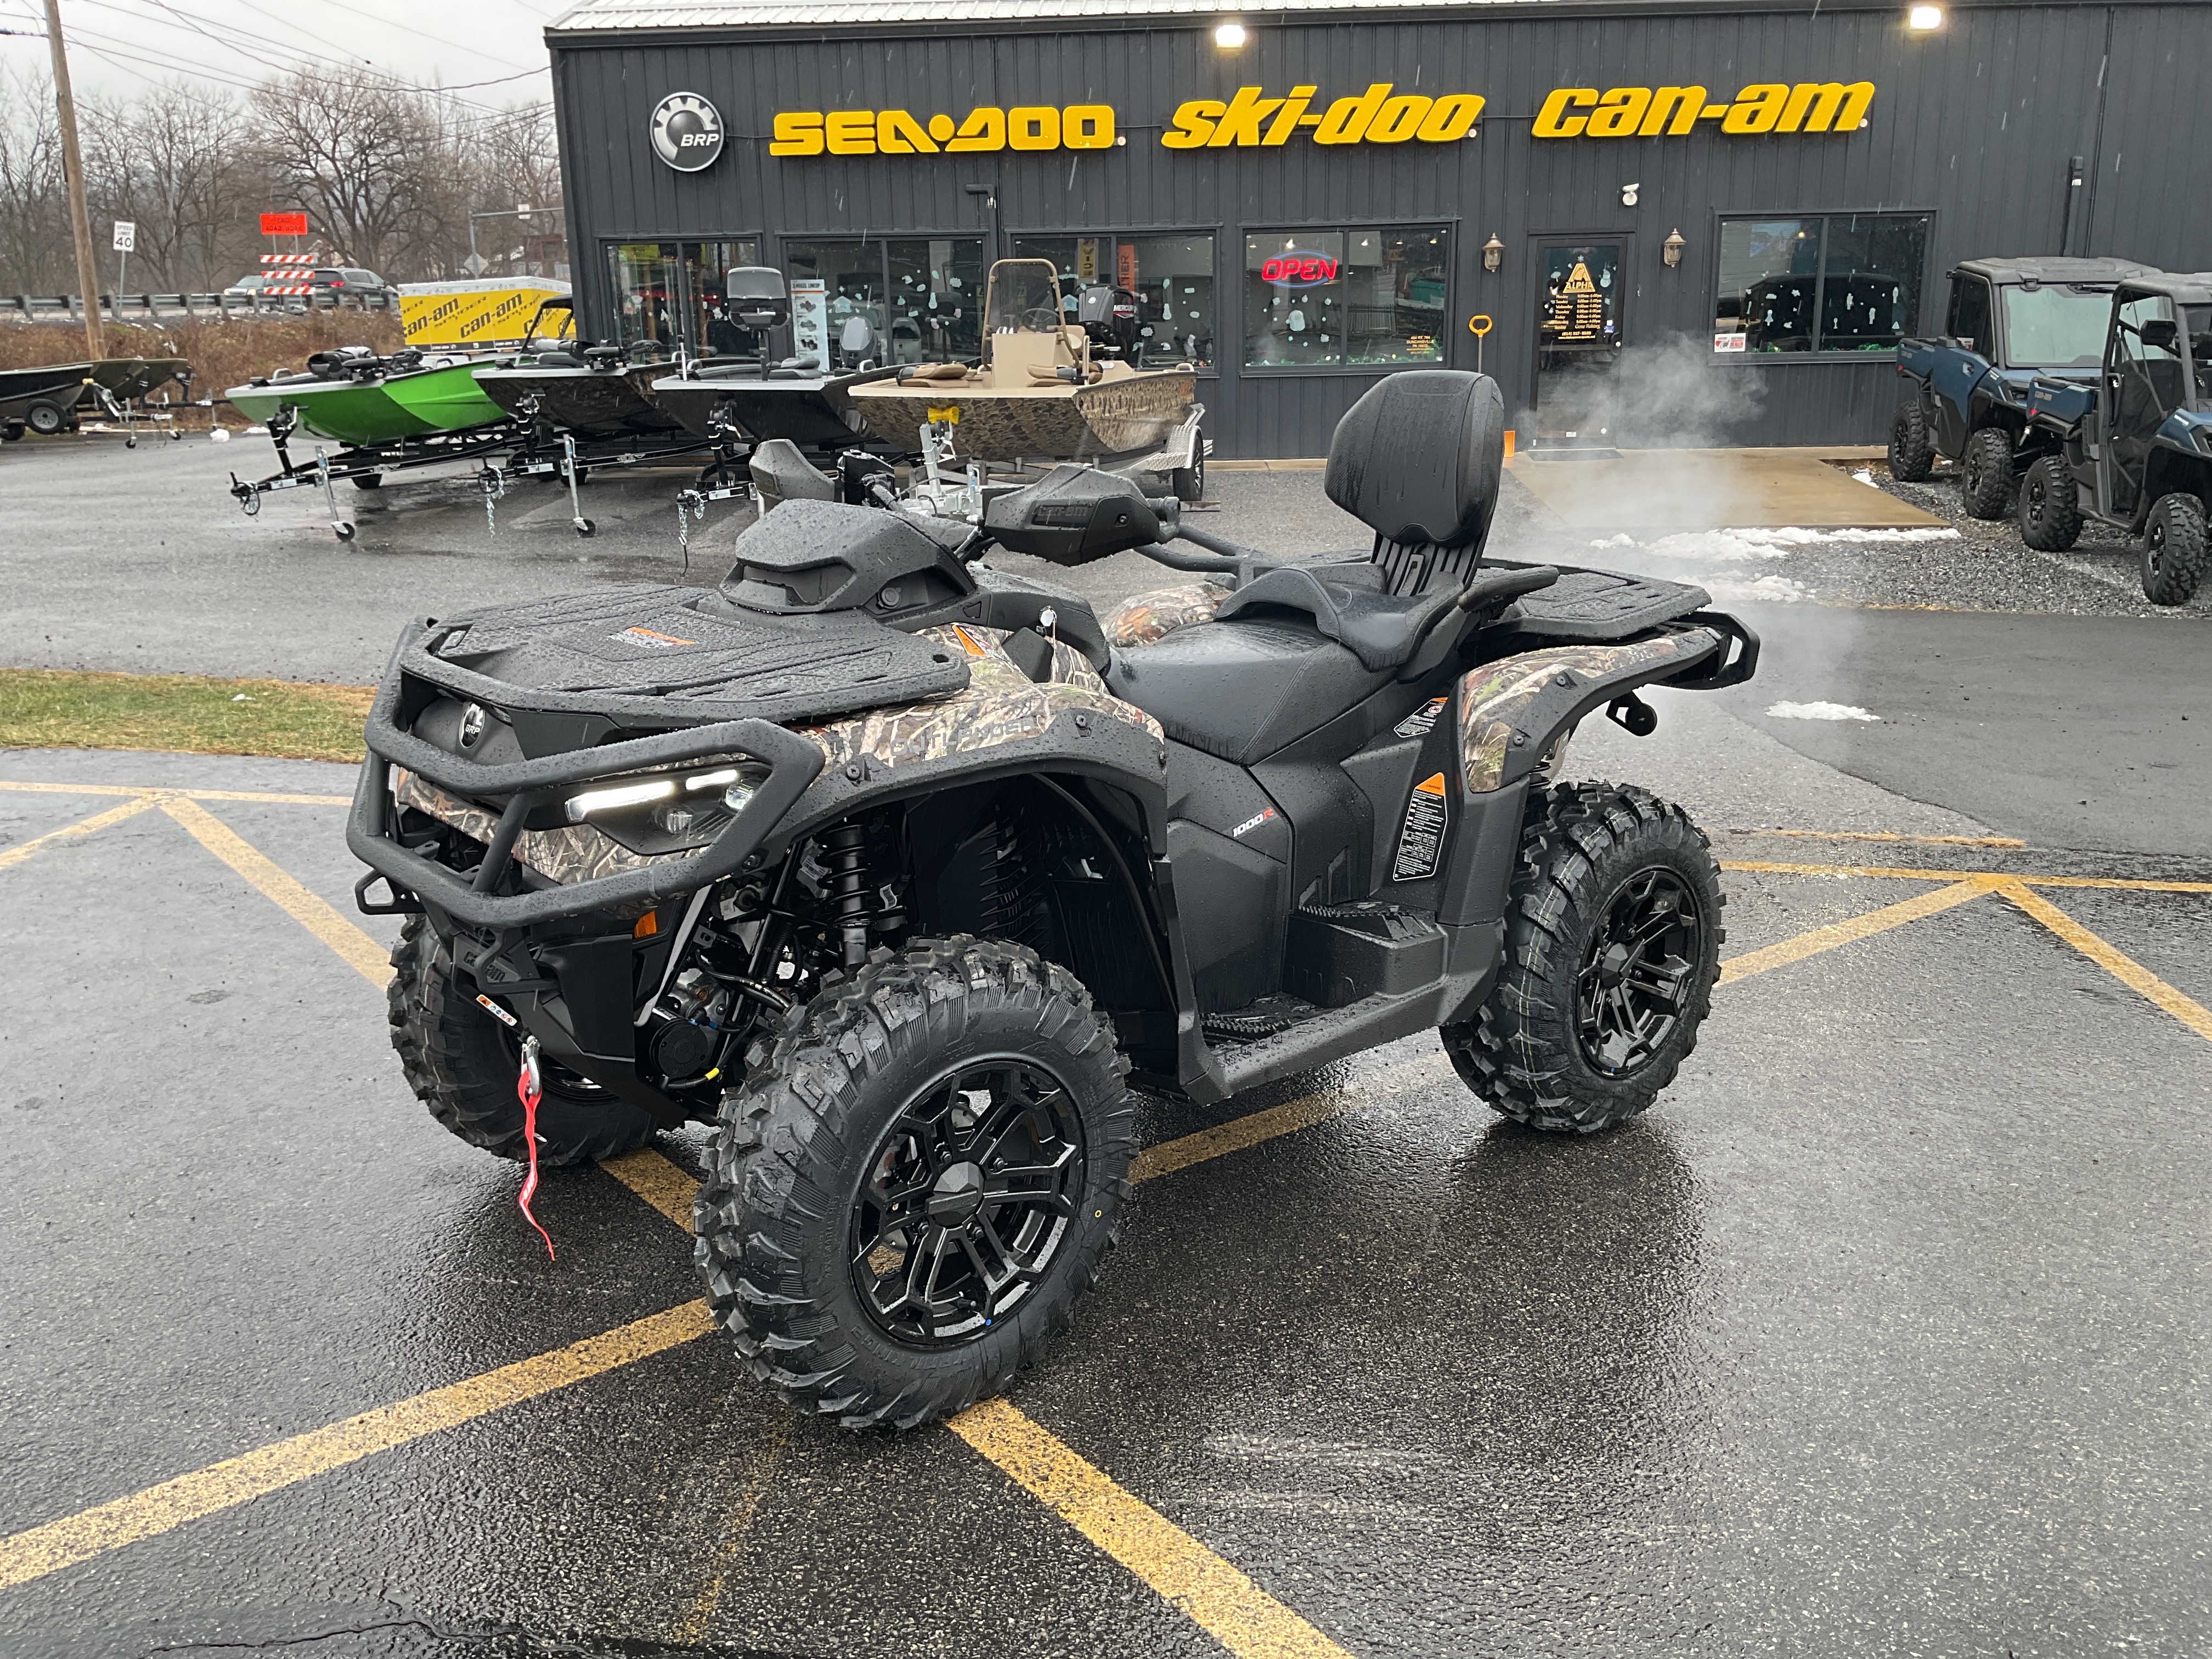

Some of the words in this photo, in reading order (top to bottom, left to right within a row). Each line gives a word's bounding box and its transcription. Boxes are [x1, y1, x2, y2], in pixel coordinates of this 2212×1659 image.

[680, 133, 719, 146] BRP
[115, 236, 132, 247] 40
[1262, 258, 1338, 280] OPEN
[465, 724, 481, 735] BRP
[890, 716, 1035, 757] OUTLANDER
[1233, 808, 1274, 837] 1000R
